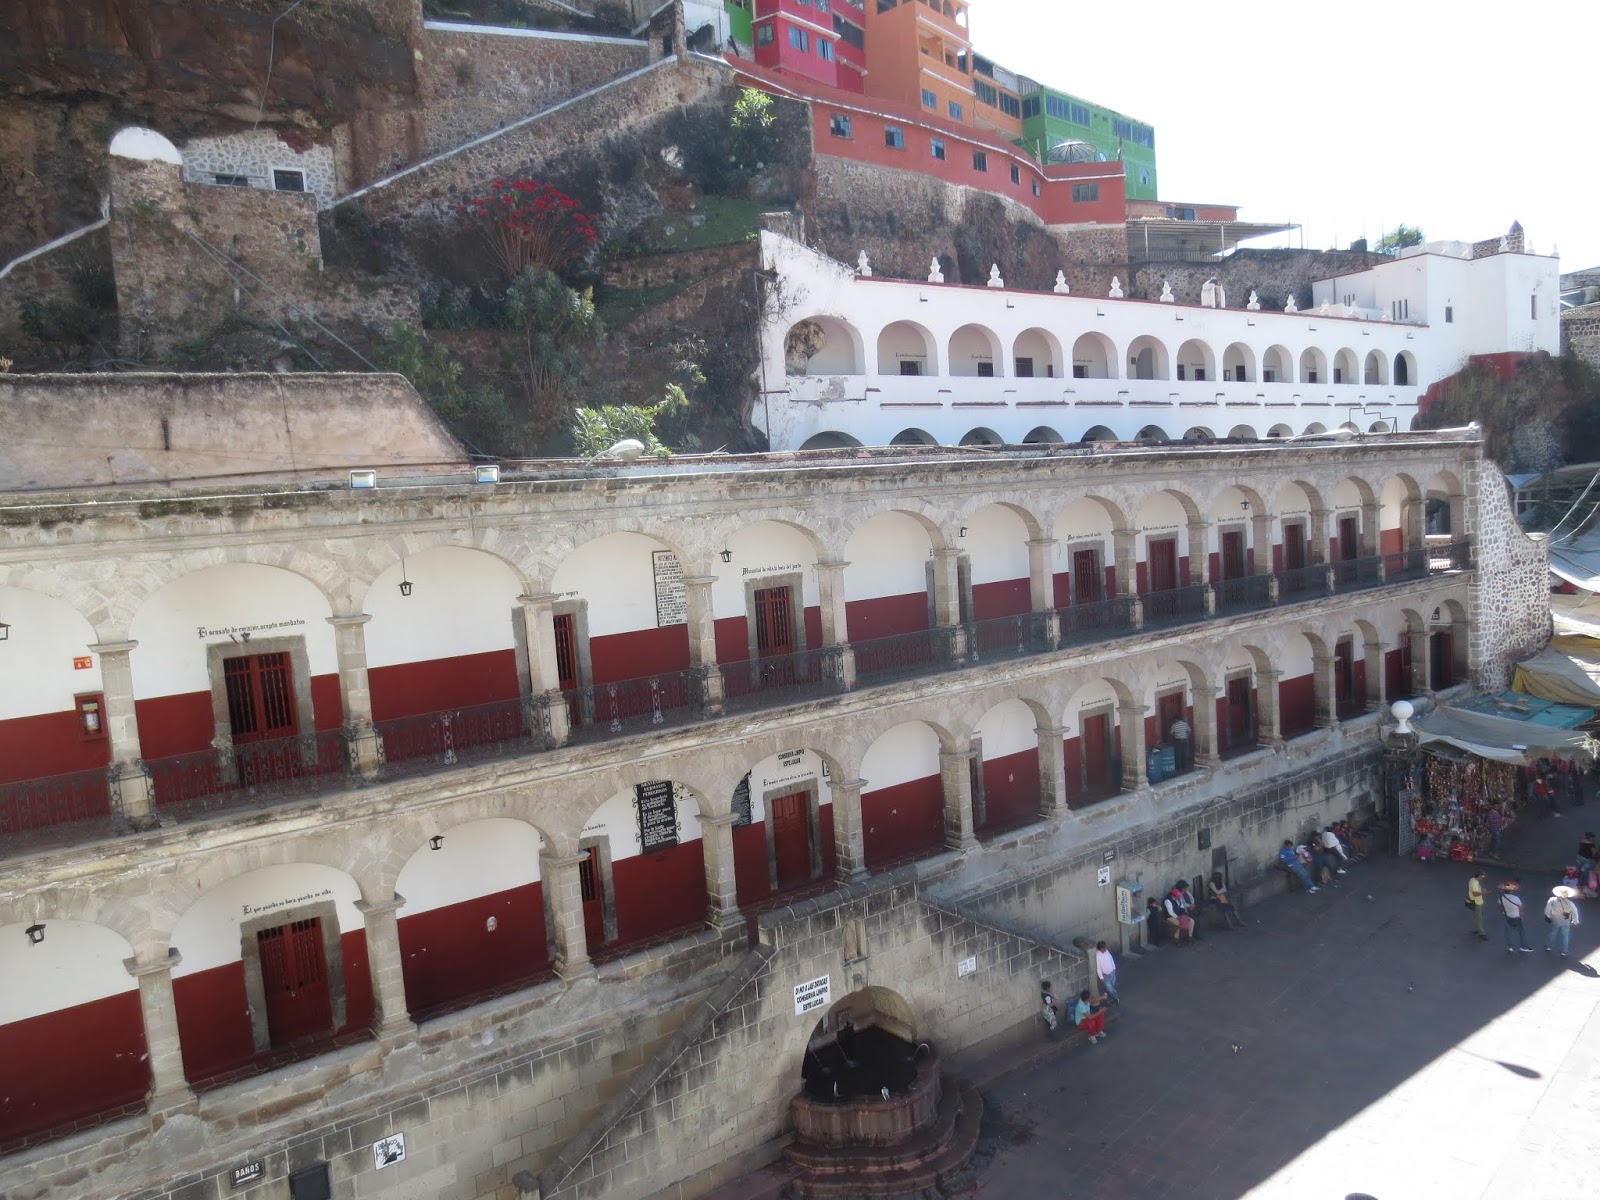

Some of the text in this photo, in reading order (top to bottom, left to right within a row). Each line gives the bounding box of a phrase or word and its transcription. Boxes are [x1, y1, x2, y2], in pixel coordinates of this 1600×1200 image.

[814, 978, 828, 988] DROGAS
[797, 991, 815, 1003] CONSERVA
[802, 1002, 811, 1011] ESTE
